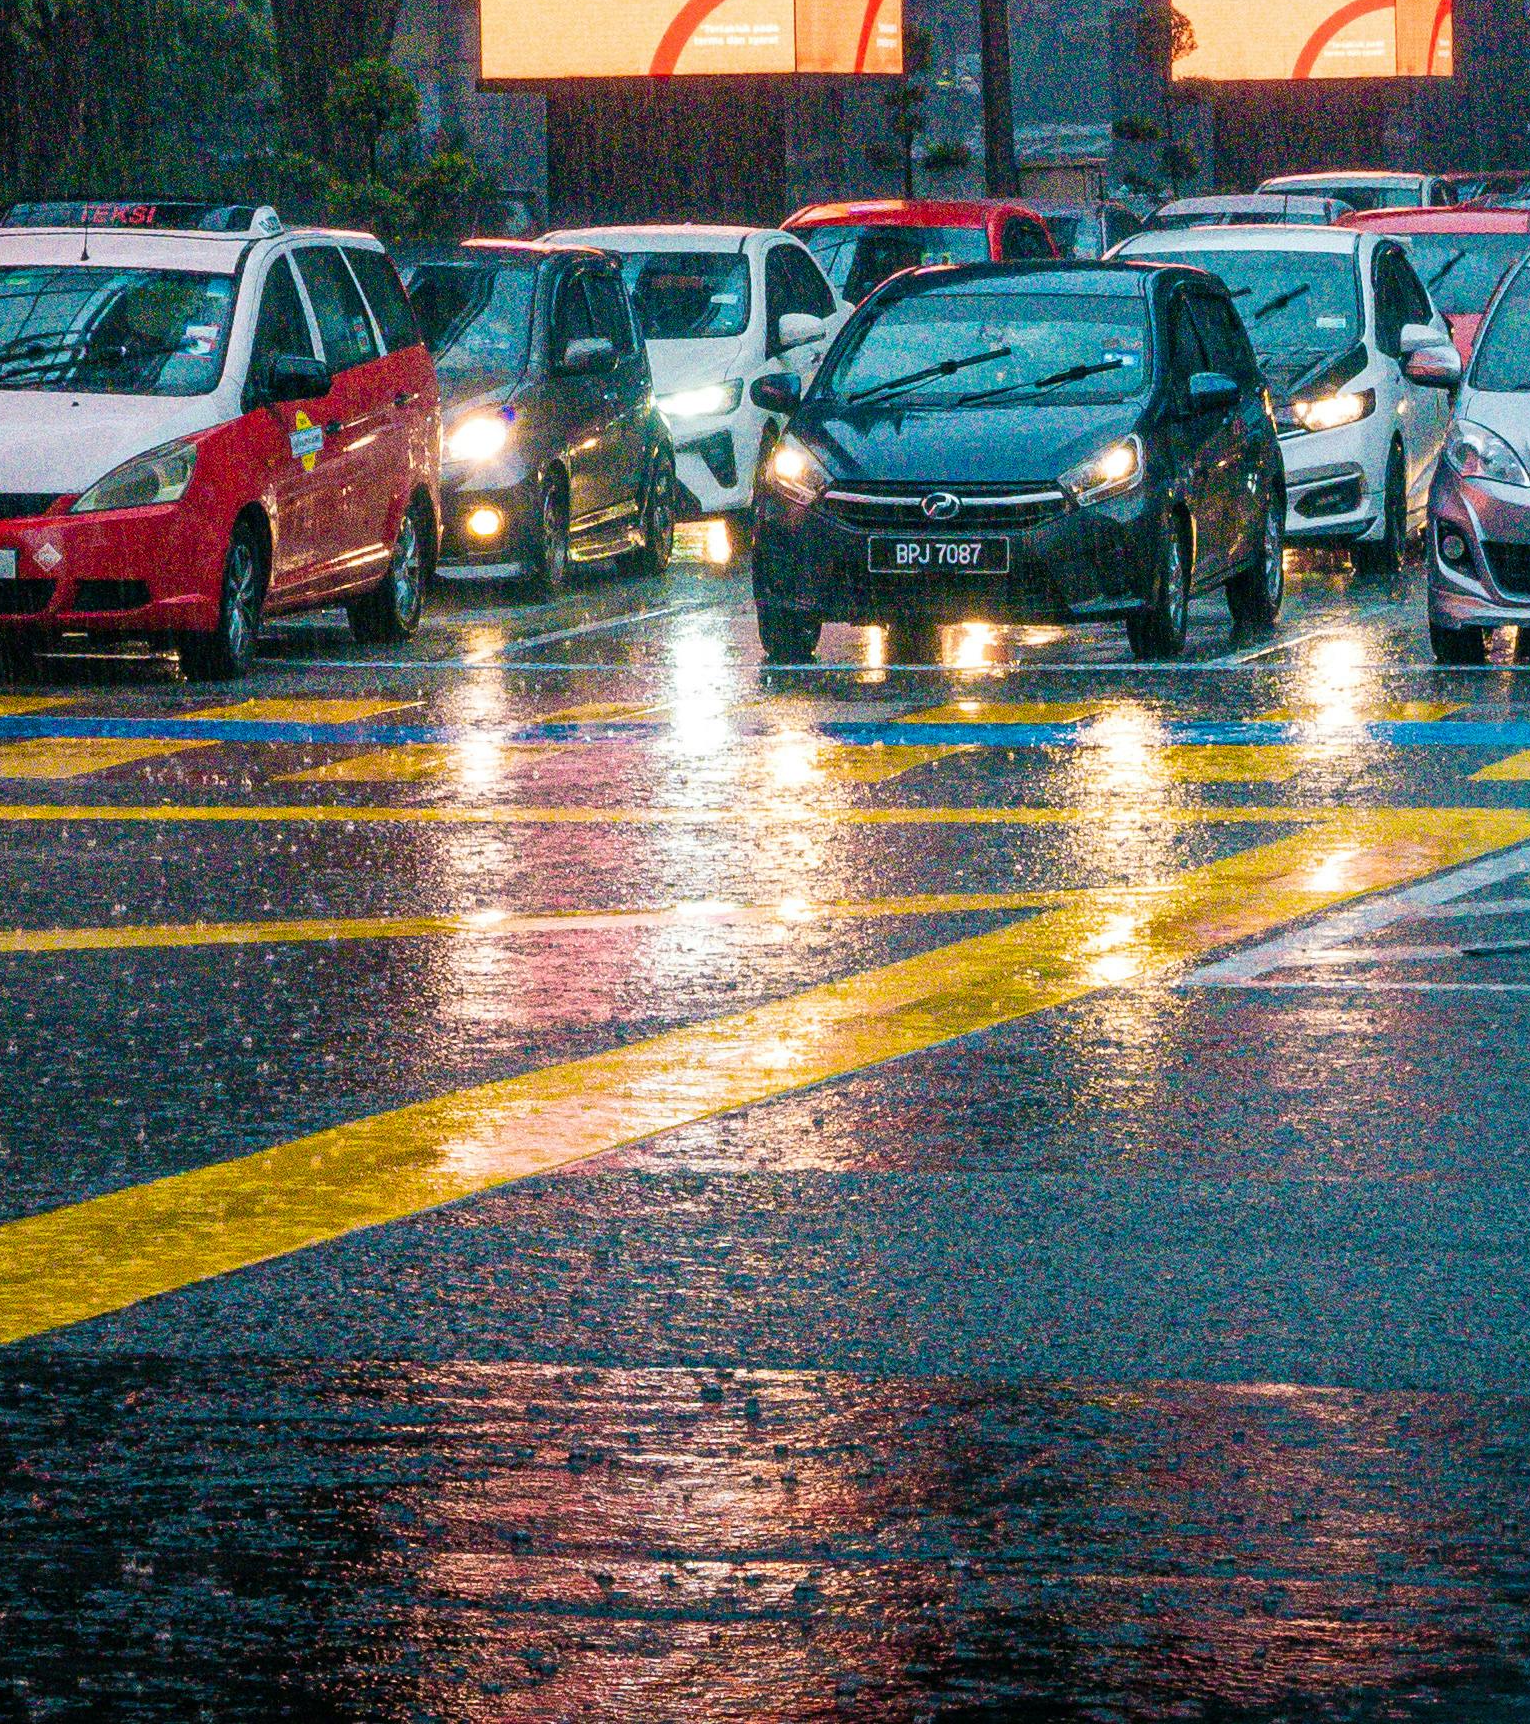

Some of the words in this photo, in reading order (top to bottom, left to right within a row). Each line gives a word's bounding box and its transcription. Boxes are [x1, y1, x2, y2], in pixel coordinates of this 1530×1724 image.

[81, 205, 157, 224] TEKSI
[896, 543, 930, 564] BPJ
[935, 543, 982, 564] 7087
